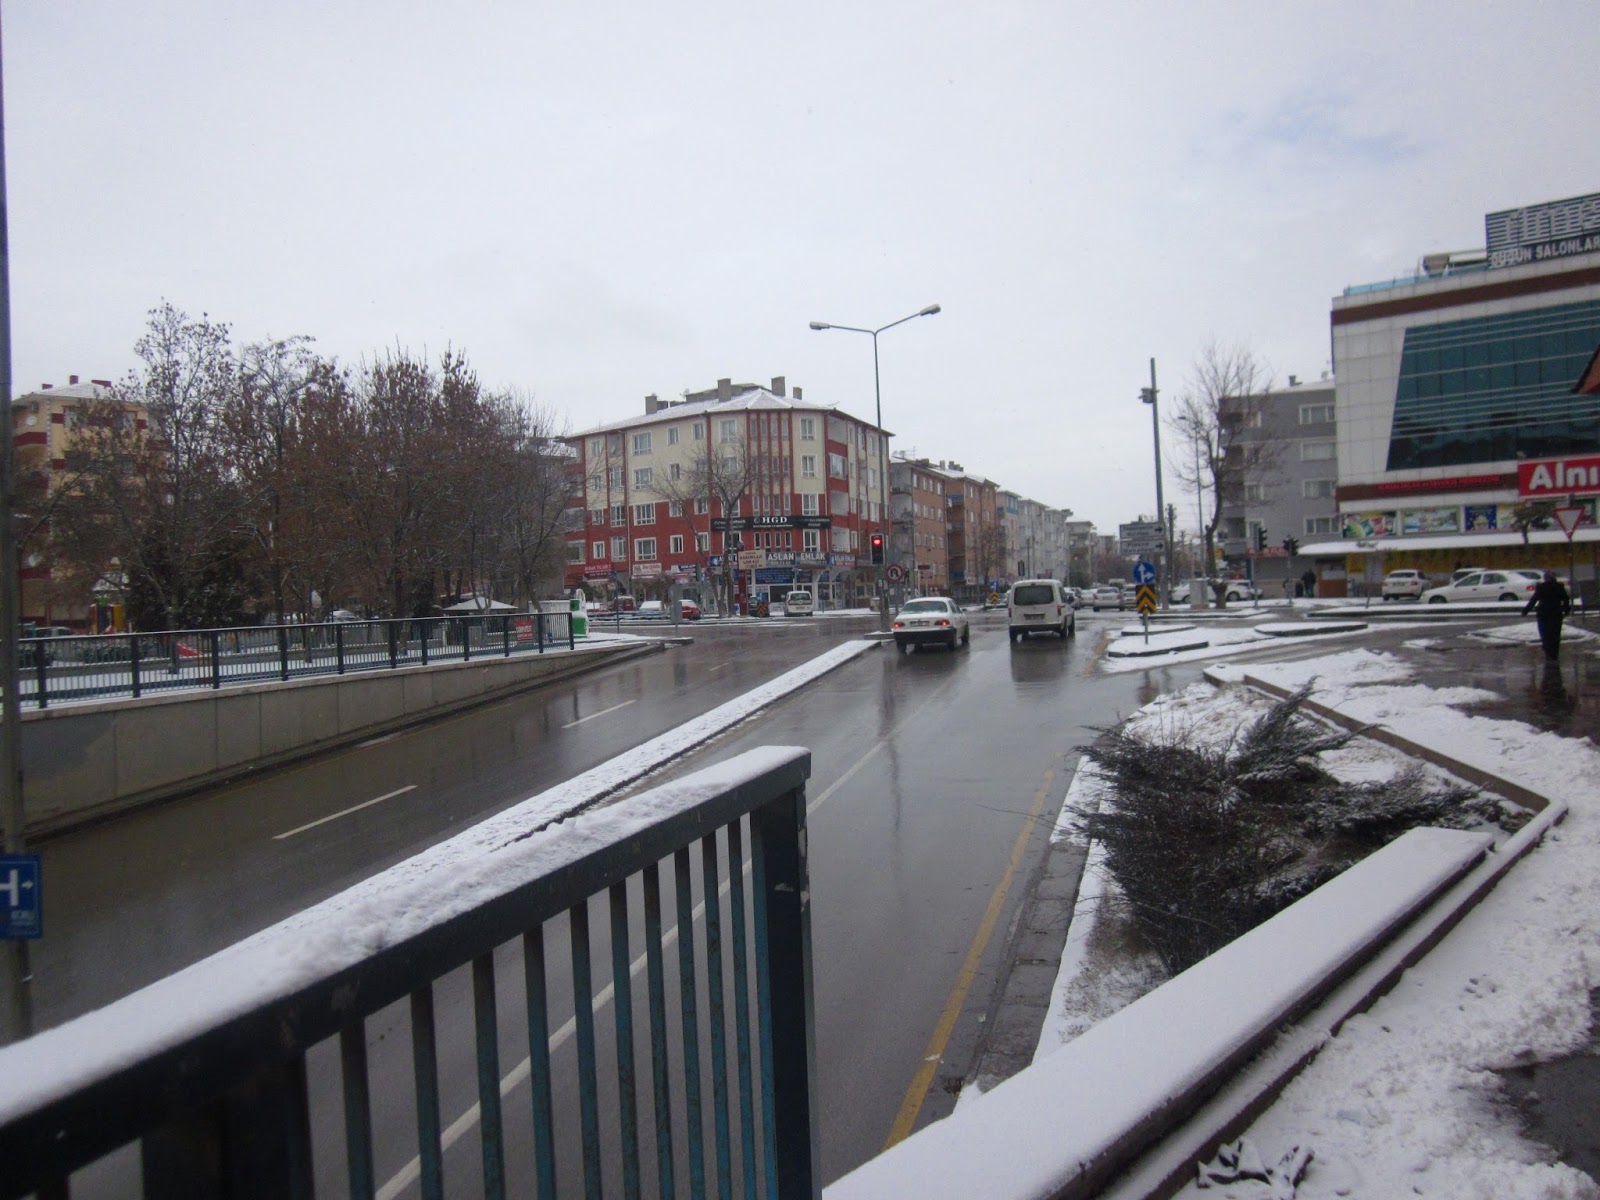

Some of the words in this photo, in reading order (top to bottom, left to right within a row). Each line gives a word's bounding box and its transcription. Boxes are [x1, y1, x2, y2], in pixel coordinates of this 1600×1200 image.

[762, 516, 788, 524] HGD
[767, 552, 794, 561] ASLAN
[800, 552, 826, 561] EMLAK
